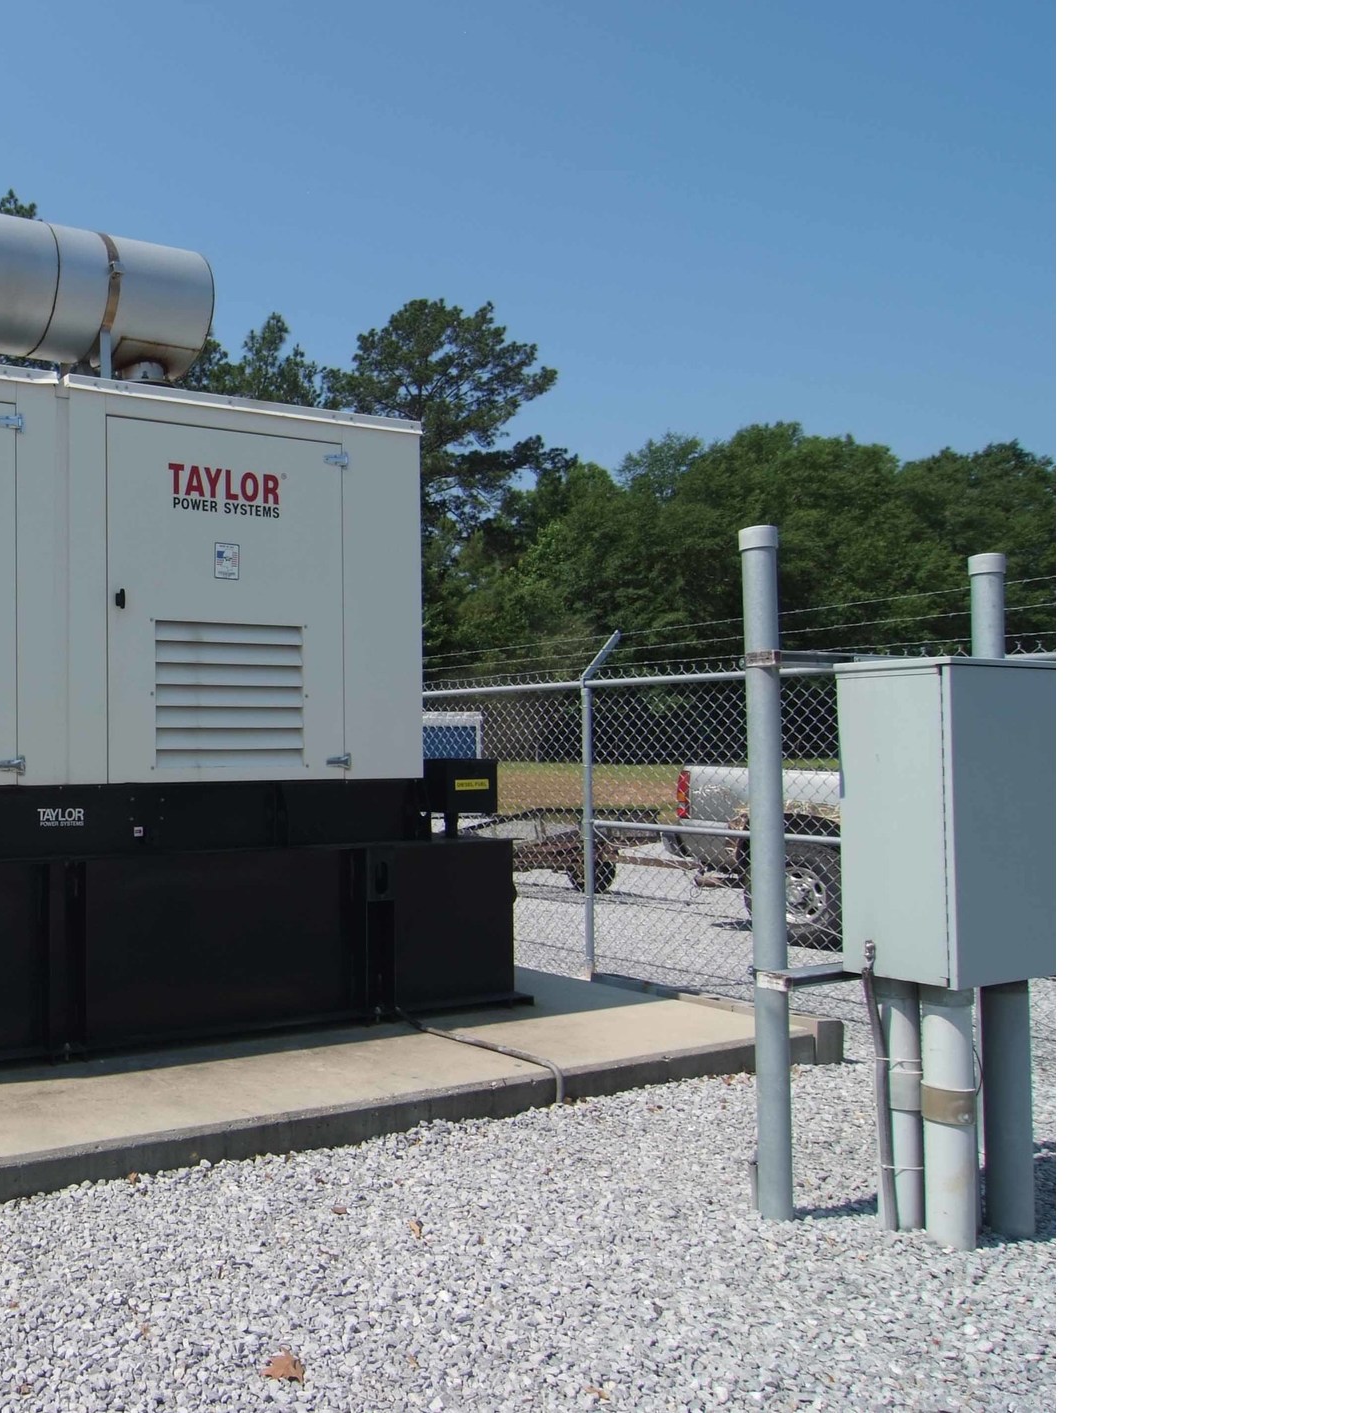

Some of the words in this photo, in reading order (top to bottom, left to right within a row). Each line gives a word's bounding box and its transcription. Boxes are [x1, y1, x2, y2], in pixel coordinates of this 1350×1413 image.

[168, 462, 280, 505] TAYLOR
[173, 497, 218, 513] POWER
[224, 502, 280, 519] SYSTEMS
[37, 808, 85, 821] TAYLOR
